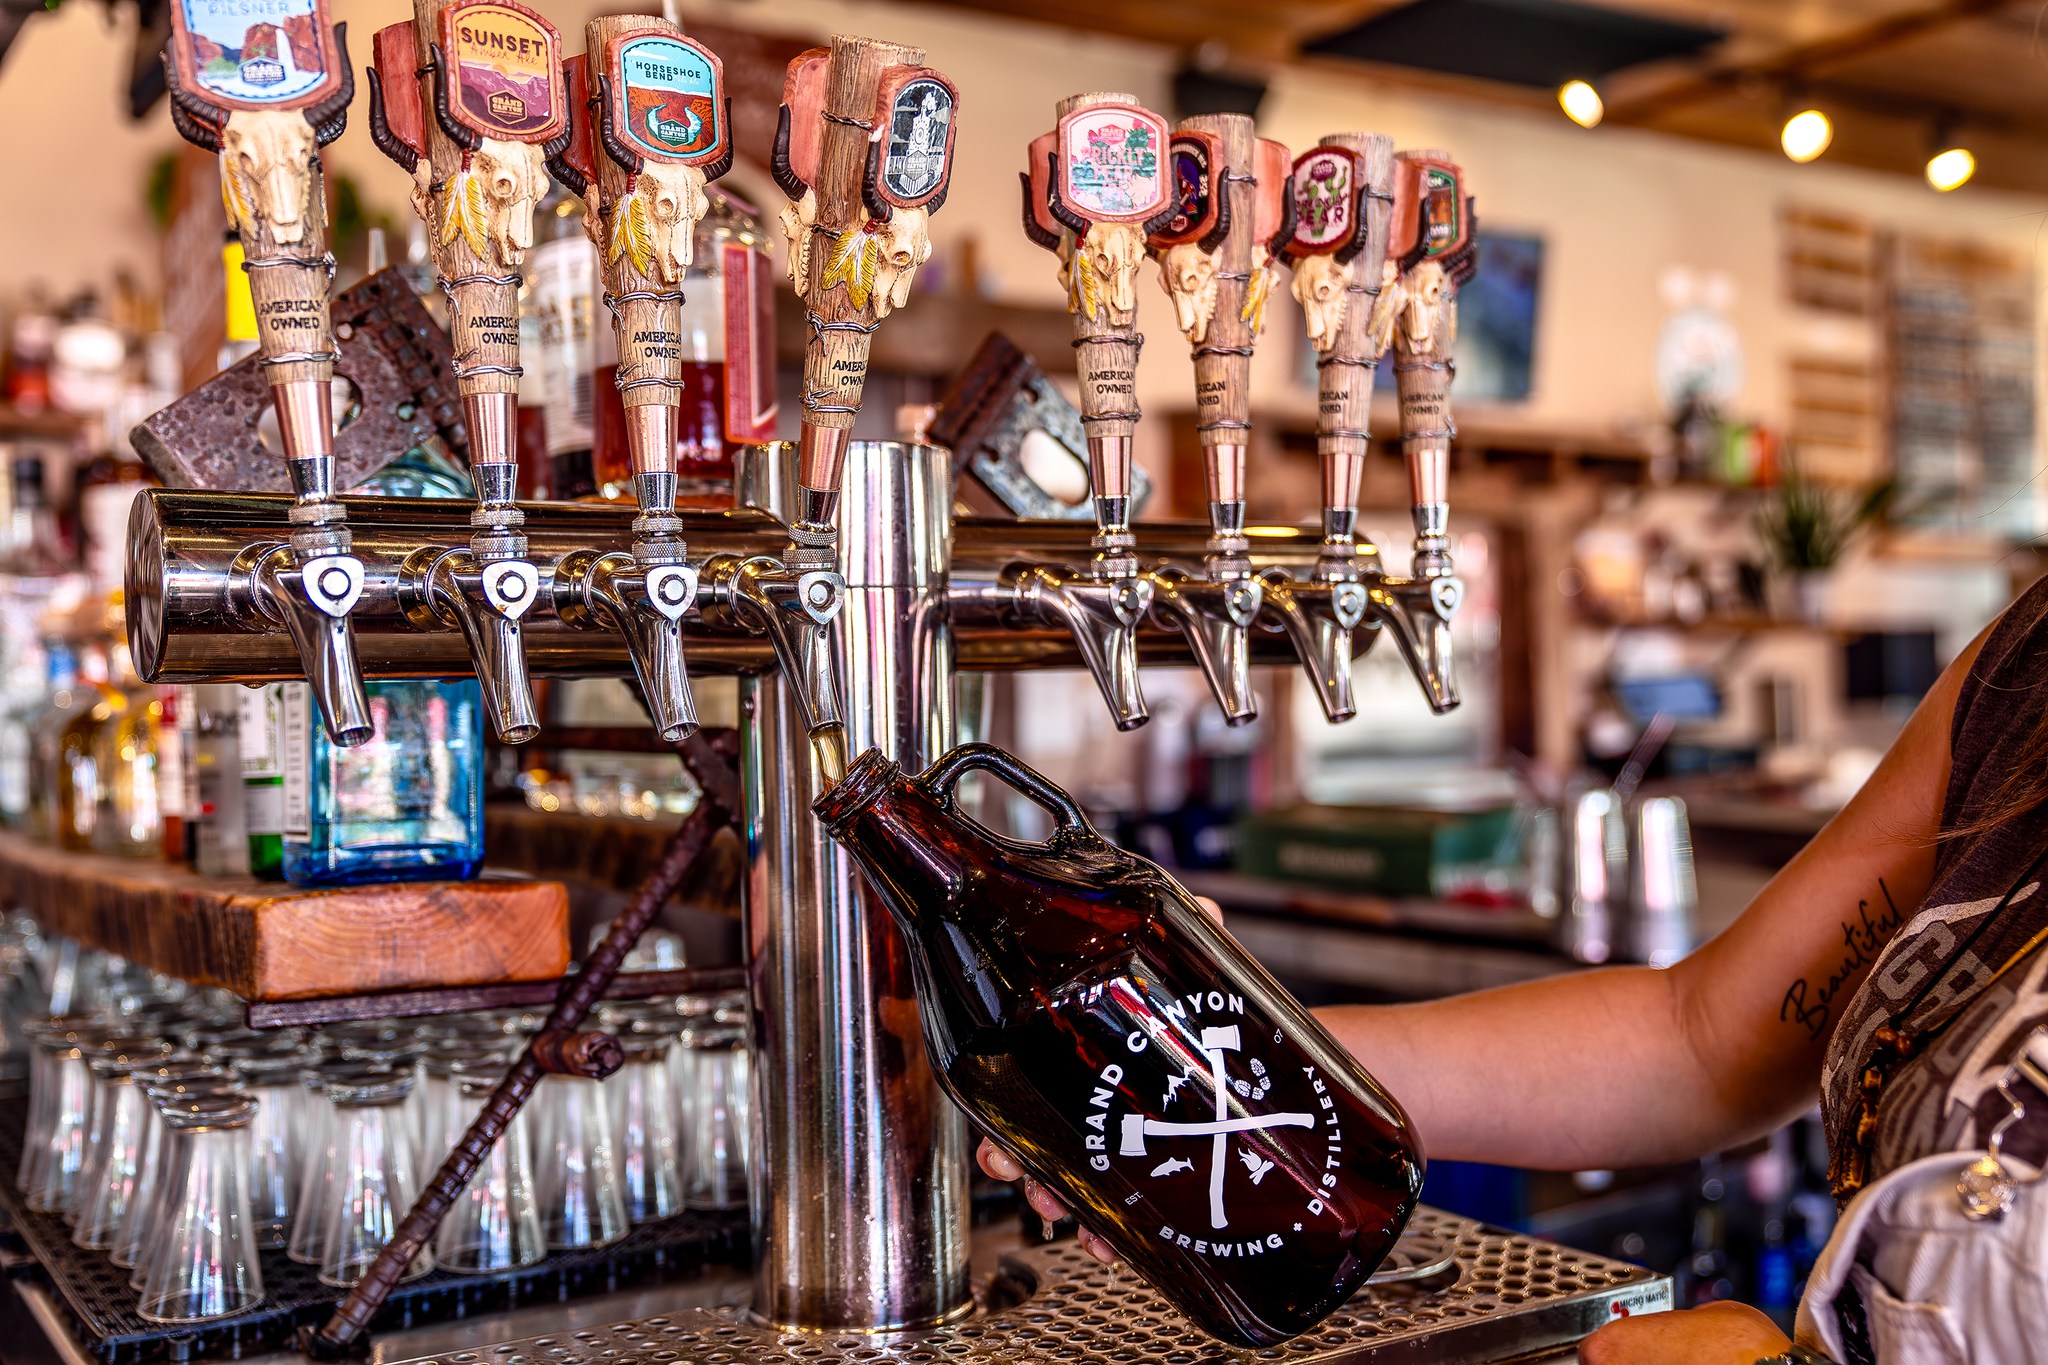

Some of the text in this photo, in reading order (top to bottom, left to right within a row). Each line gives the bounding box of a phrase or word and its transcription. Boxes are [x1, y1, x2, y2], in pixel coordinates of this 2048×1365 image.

[208, 1, 289, 16] PILSNER
[461, 27, 543, 57] SUNSET
[636, 61, 701, 79] HORSESHOE
[645, 71, 673, 81] BEND
[492, 96, 523, 108] GRAND
[660, 124, 686, 132] GRAND
[1081, 146, 1144, 165] PRICKLY
[271, 317, 320, 331] OWNED
[469, 316, 519, 330] AMERICA
[482, 332, 519, 345] OWNE
[632, 331, 681, 345] AMERICA
[644, 346, 680, 360] OWNE
[841, 375, 864, 386] OWN
[1196, 381, 1226, 393] RICAN
[1096, 384, 1132, 395] OWNED
[1320, 390, 1349, 401] RICAN
[1198, 395, 1219, 406] NED
[1780, 877, 1905, 1040] Beautiful
[1273, 1028, 1283, 1044] 07
[1086, 991, 1244, 1171] GRAND CANYON
[1159, 1065, 1341, 1257] BREWING DISTILLERY
[1124, 1191, 1144, 1206] EST.
[1620, 1291, 1667, 1308] MICRO MATIC
